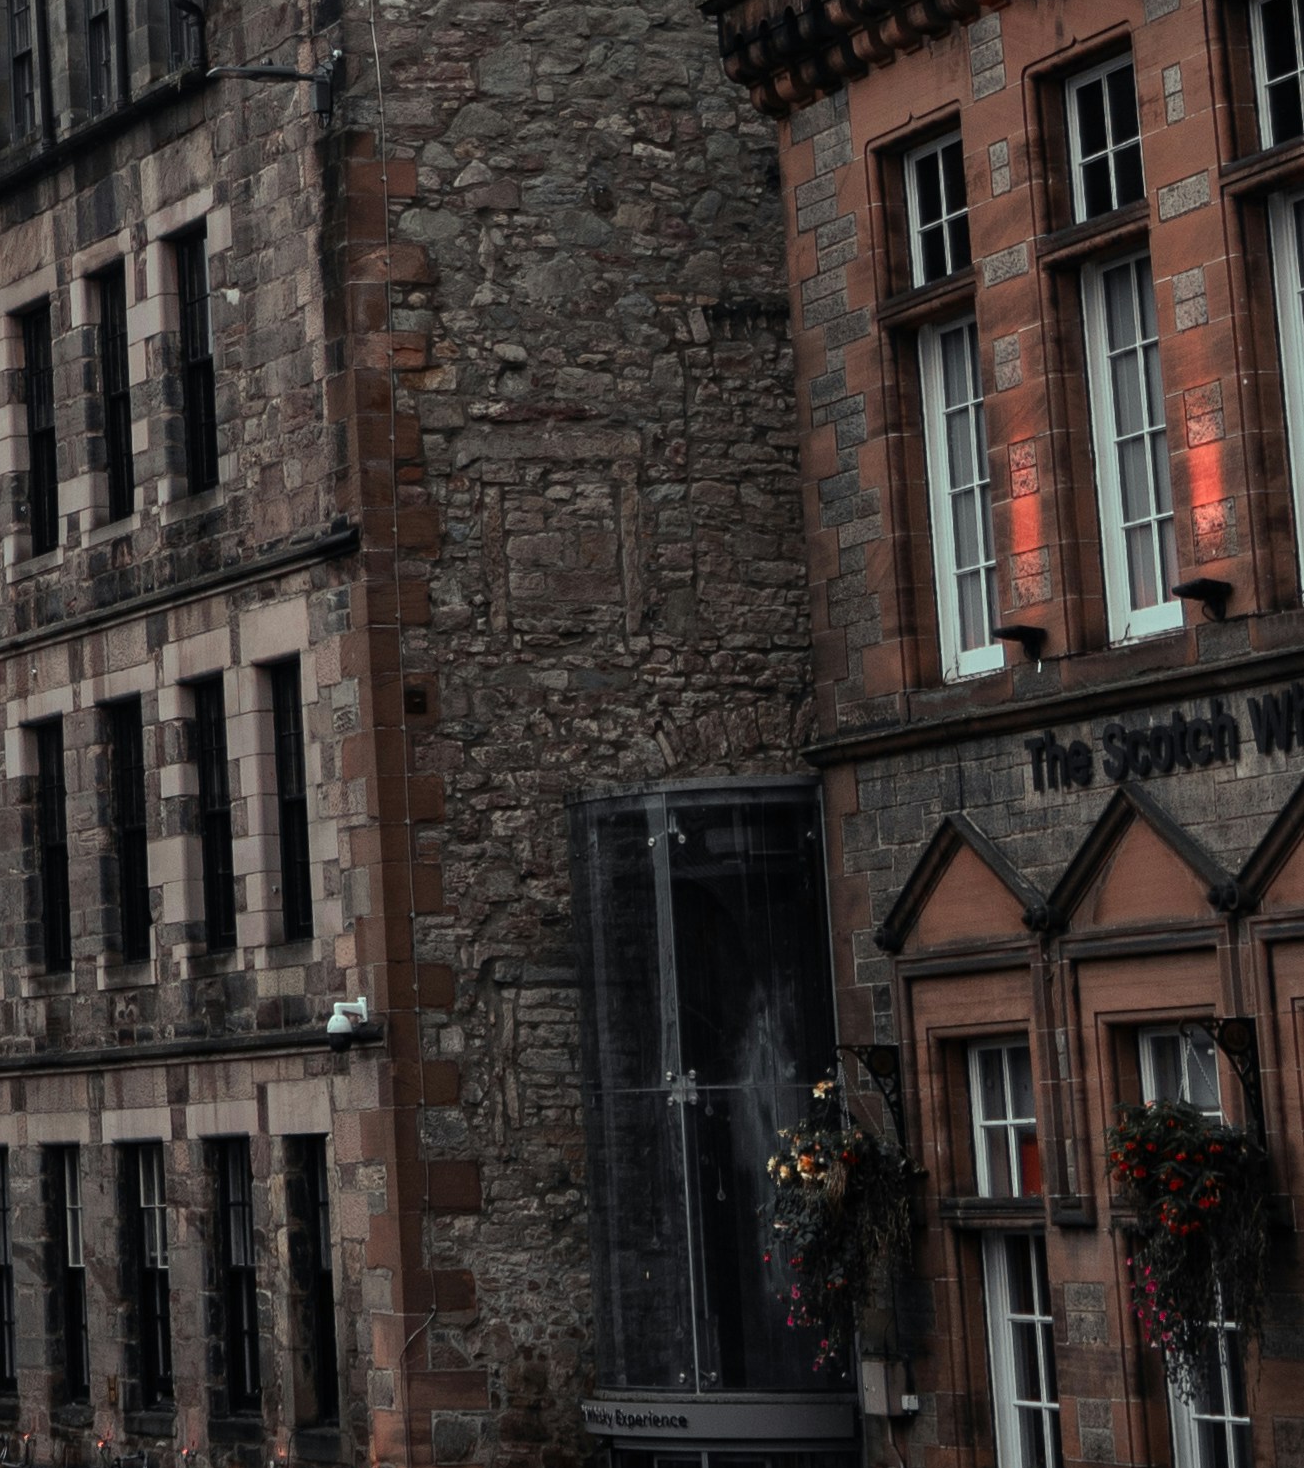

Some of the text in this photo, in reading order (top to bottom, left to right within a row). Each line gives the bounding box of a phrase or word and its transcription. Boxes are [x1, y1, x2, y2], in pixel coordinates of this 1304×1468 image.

[1025, 729, 1092, 782] The
[1102, 697, 1239, 781] Scotch
[615, 1409, 688, 1429] Experience
